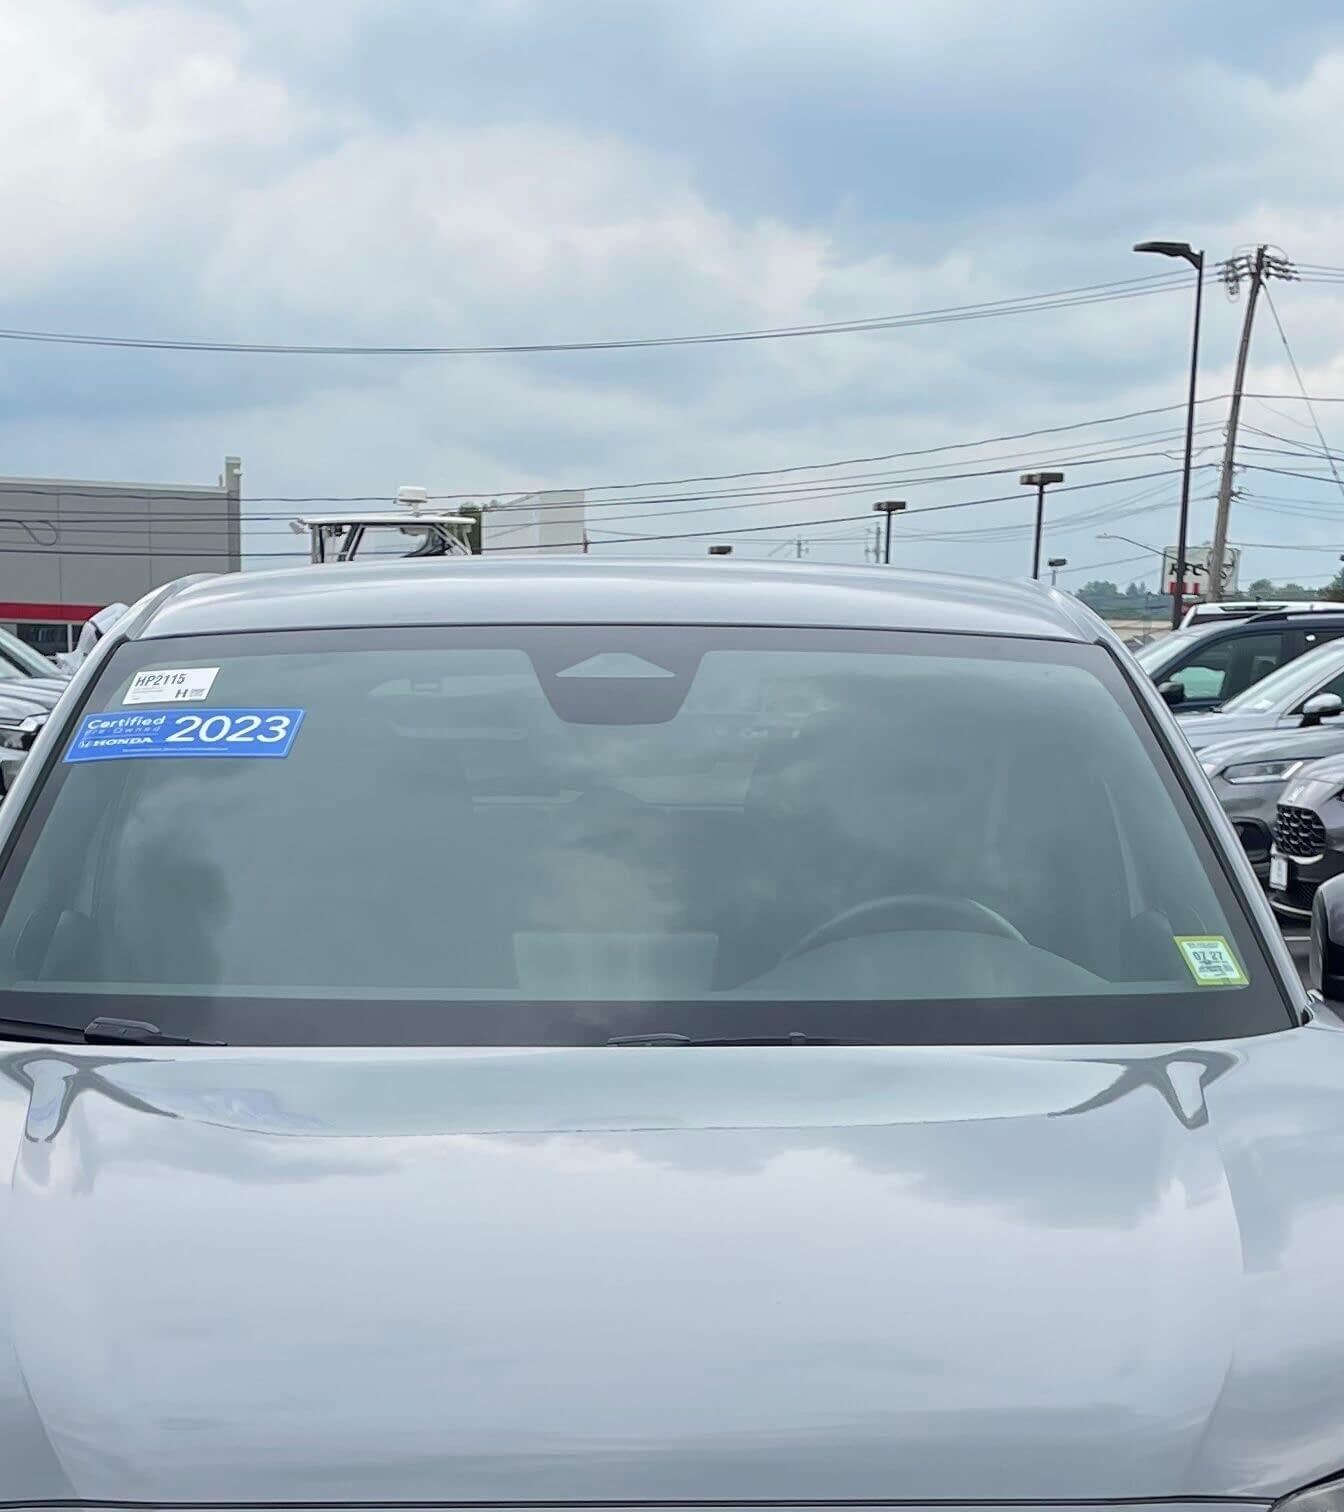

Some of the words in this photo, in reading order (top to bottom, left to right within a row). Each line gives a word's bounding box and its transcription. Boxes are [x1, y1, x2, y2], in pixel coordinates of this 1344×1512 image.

[136, 673, 186, 687] HP2115
[87, 715, 167, 730] Certified
[165, 715, 291, 743] 2023
[93, 736, 154, 747] HONDA
